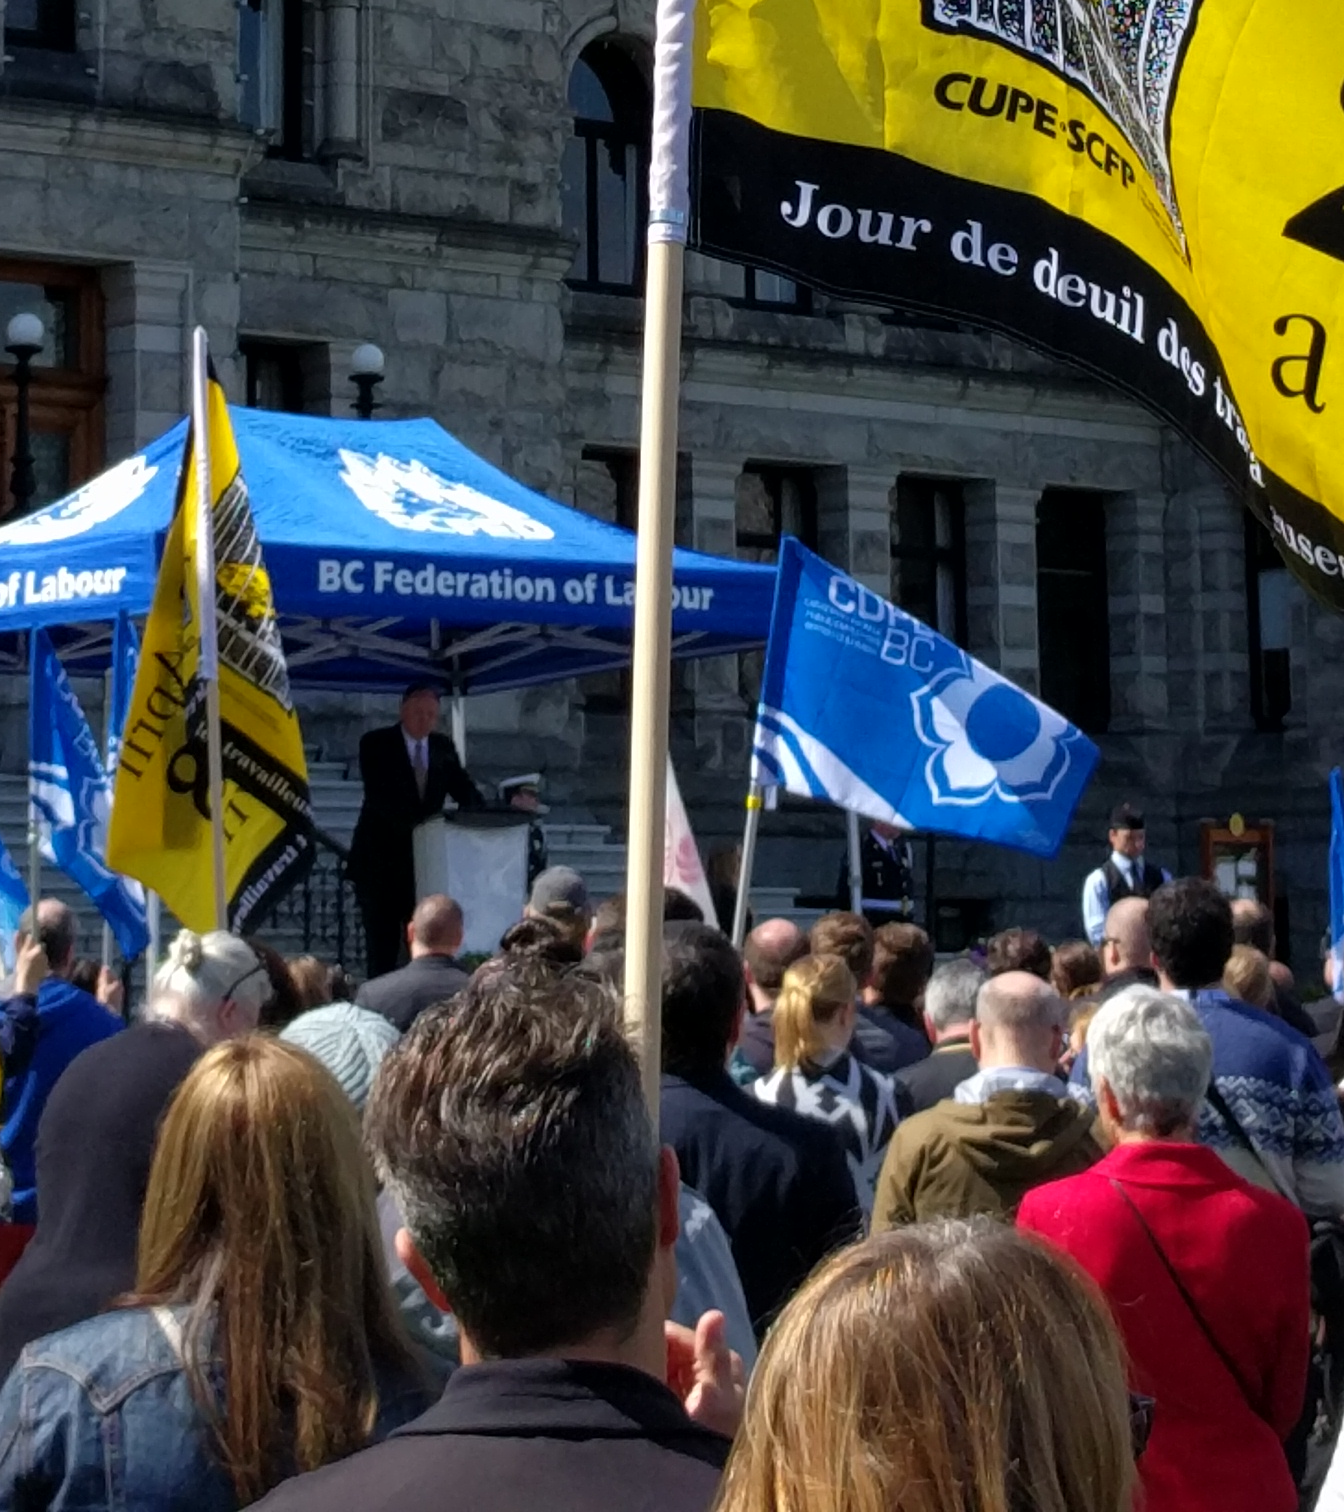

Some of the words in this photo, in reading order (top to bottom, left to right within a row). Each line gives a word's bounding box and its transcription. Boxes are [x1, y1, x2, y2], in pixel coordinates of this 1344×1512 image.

[779, 180, 932, 251] Jour
[950, 219, 1019, 276] de
[1032, 248, 1147, 345] deuil
[1156, 316, 1207, 397] des
[24, 566, 127, 605] Labour
[317, 559, 364, 593] BC
[374, 561, 556, 603] Federation
[563, 573, 598, 605] of
[605, 575, 715, 611] Laur
[879, 626, 936, 674] BC
